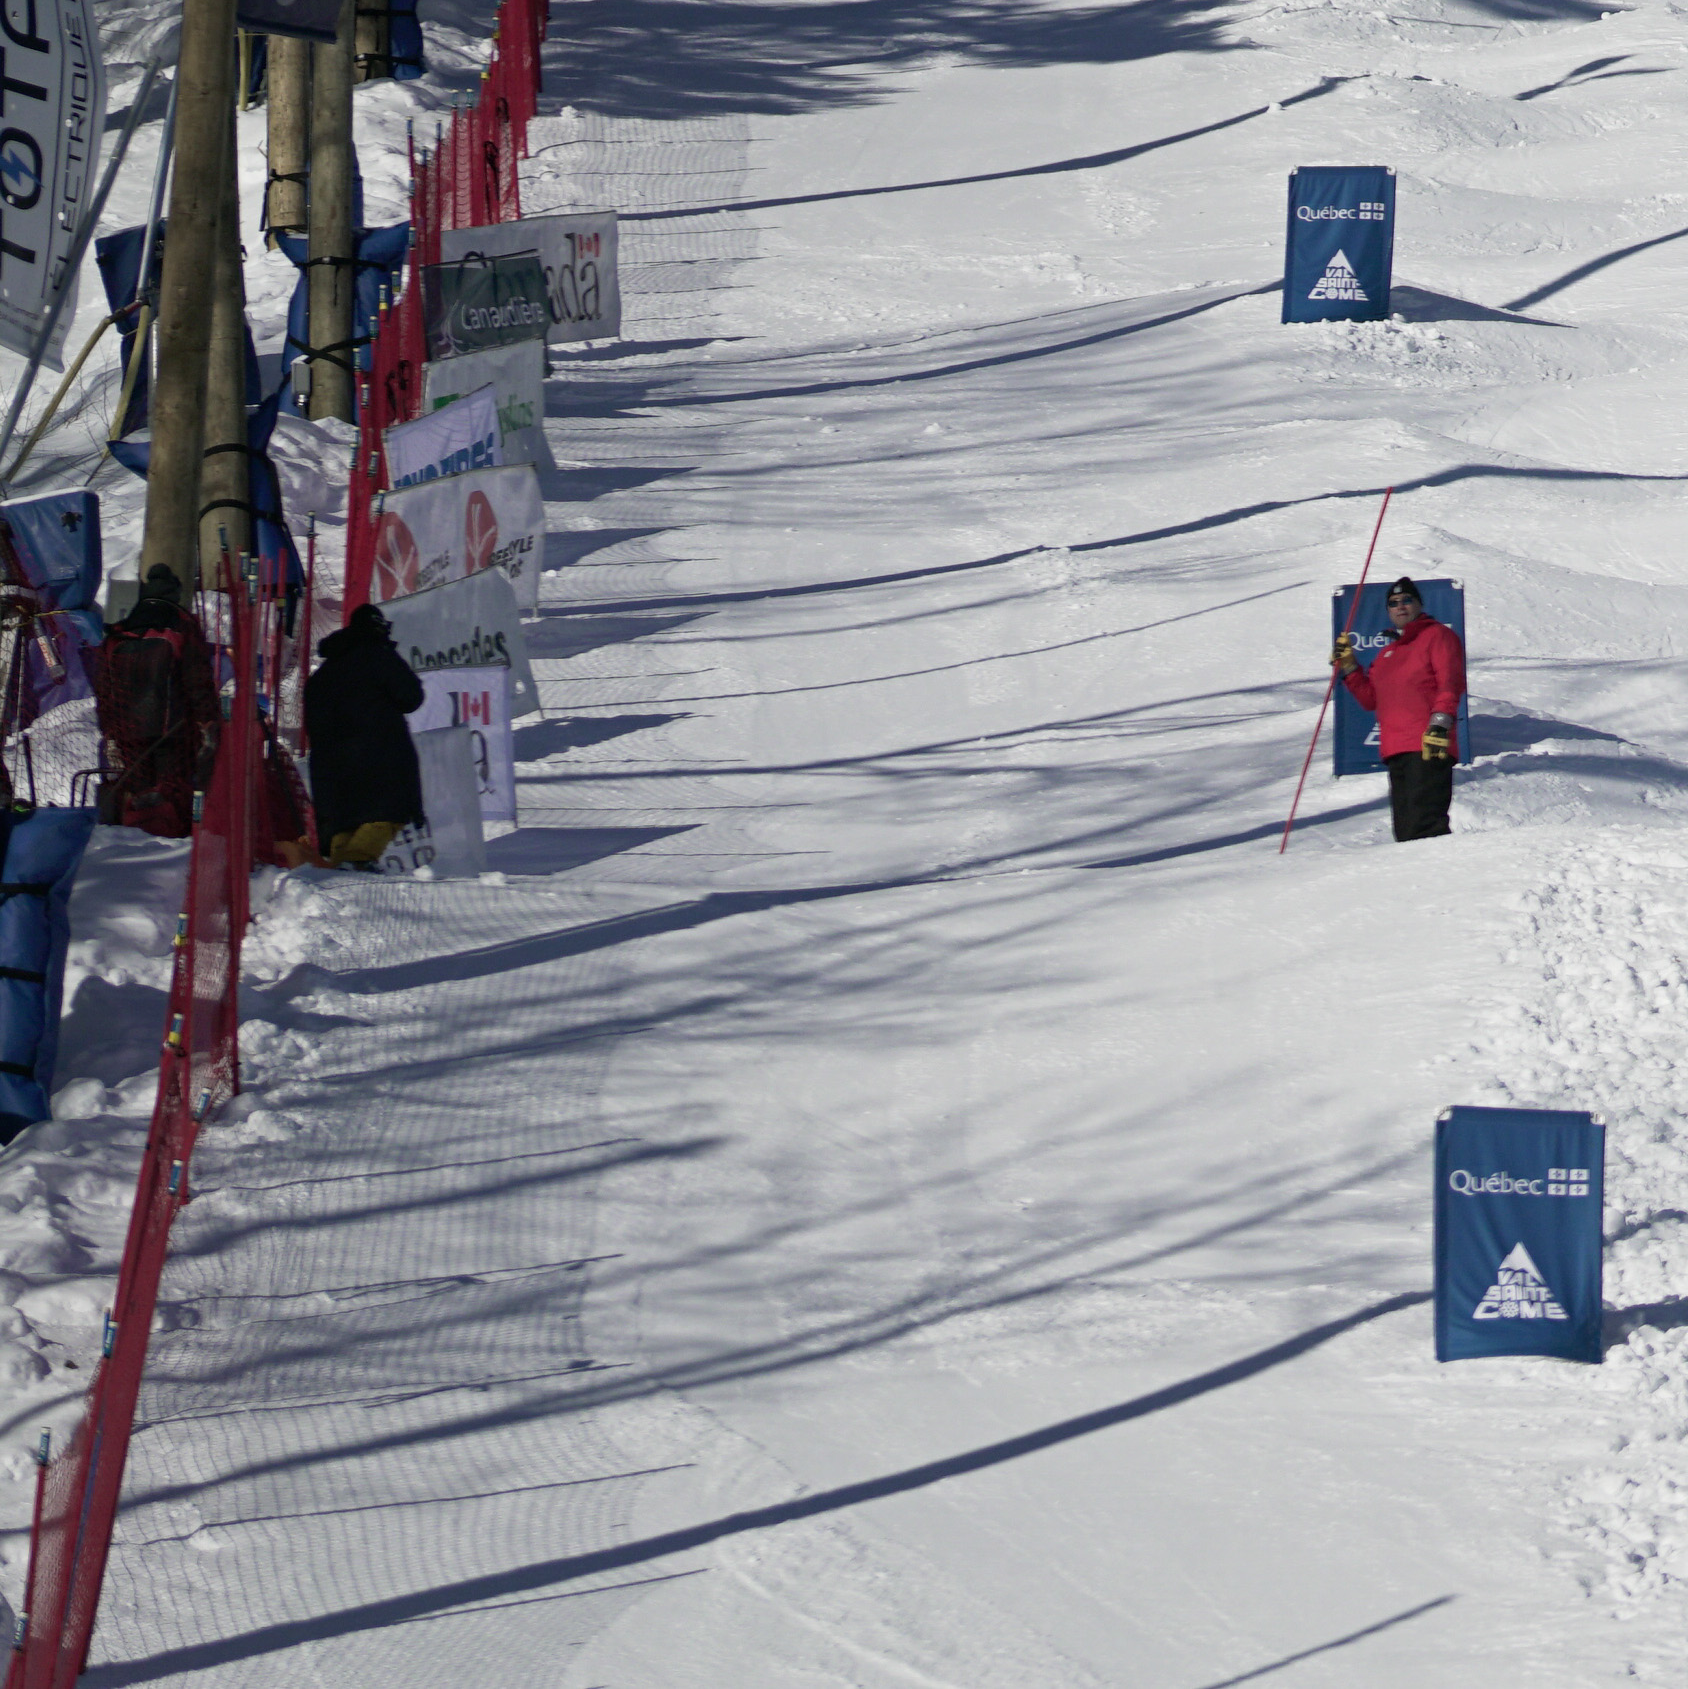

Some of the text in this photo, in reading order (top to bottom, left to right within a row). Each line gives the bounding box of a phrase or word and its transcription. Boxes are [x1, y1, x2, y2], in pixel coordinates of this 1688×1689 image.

[1296, 204, 1358, 222] Québec
[1326, 268, 1353, 278] VAL
[1449, 1168, 1547, 1197] Québec
[1497, 1270, 1541, 1287] VAL
